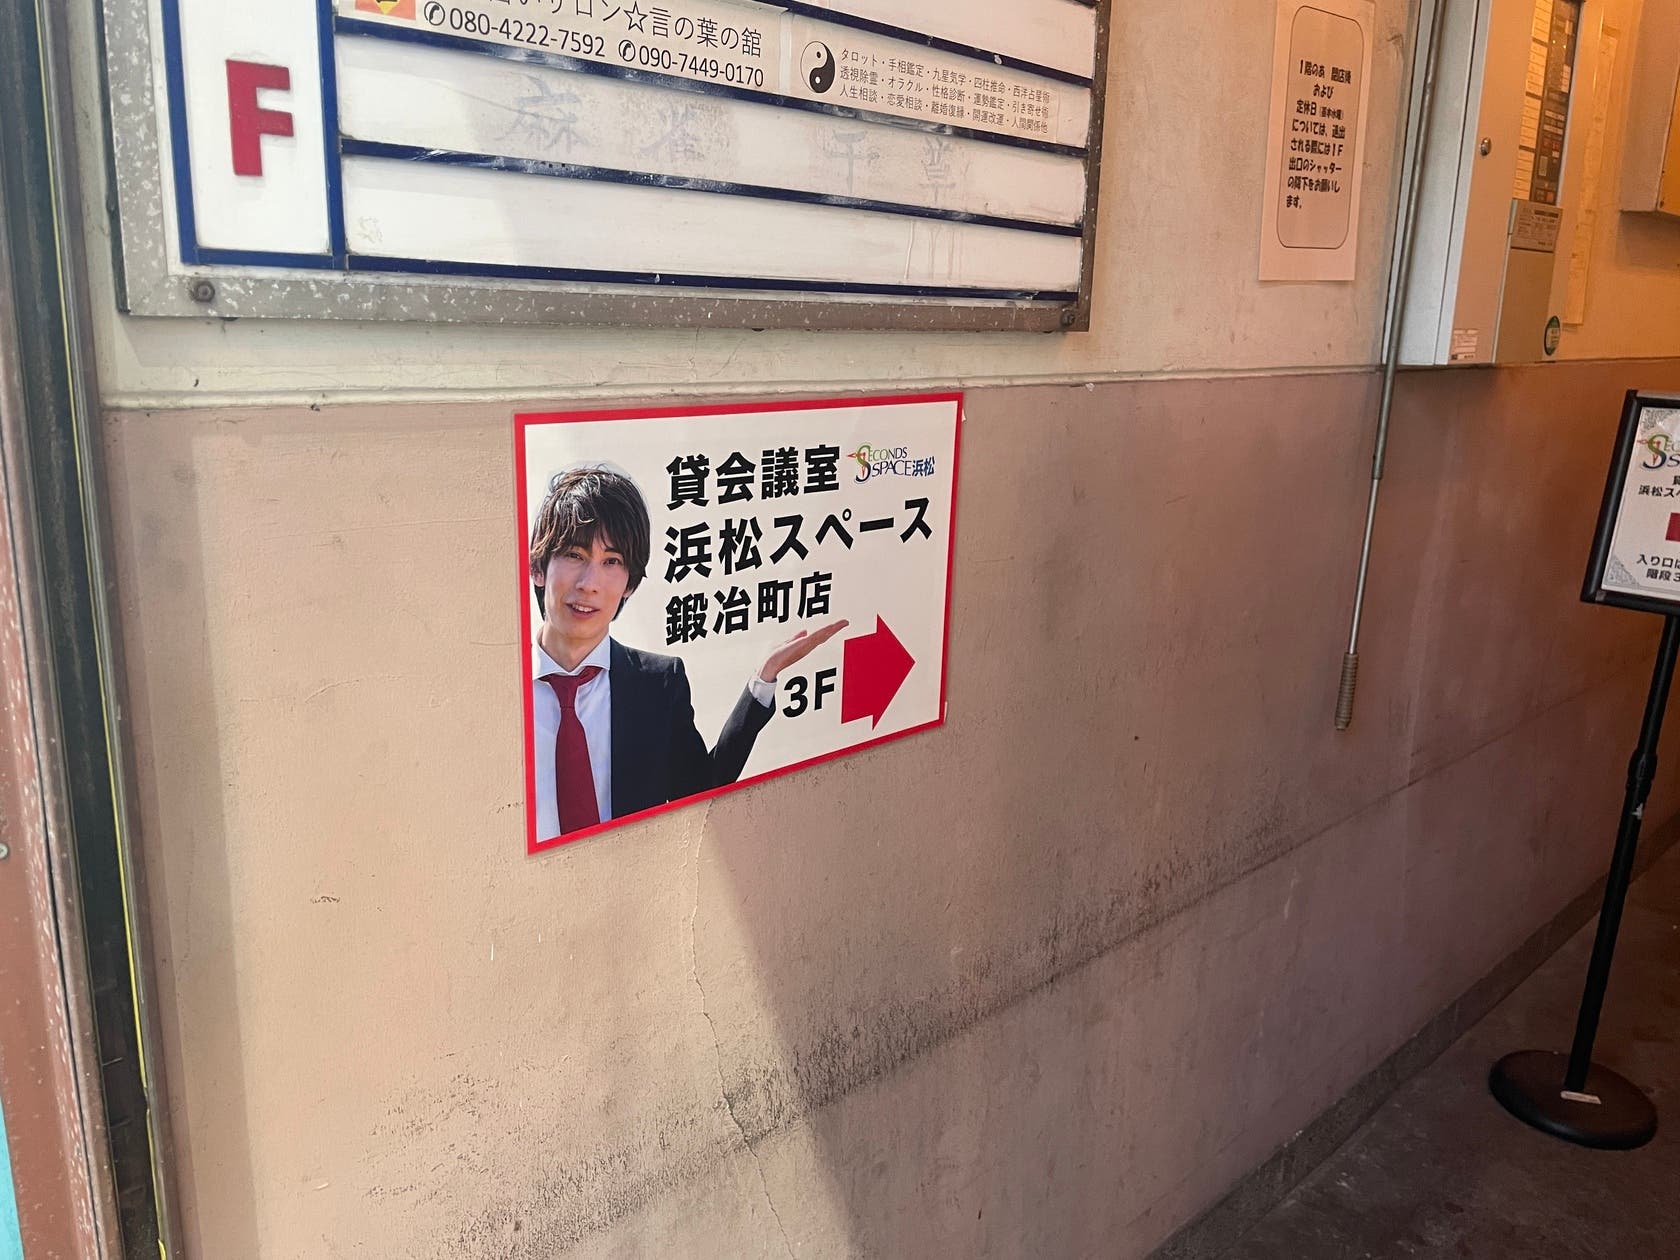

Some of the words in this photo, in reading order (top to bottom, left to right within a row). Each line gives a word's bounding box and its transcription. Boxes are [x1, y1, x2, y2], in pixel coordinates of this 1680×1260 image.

[449, 8, 606, 57] 080-4222-7592
[639, 45, 764, 88] 090-7449-0170
[226, 59, 294, 176] F
[1313, 84, 1334, 99] および
[665, 444, 841, 511] 貸会議室
[663, 497, 933, 584] 浜松スペース
[665, 571, 833, 646] 鍛冶町店
[782, 667, 837, 718] 3F
